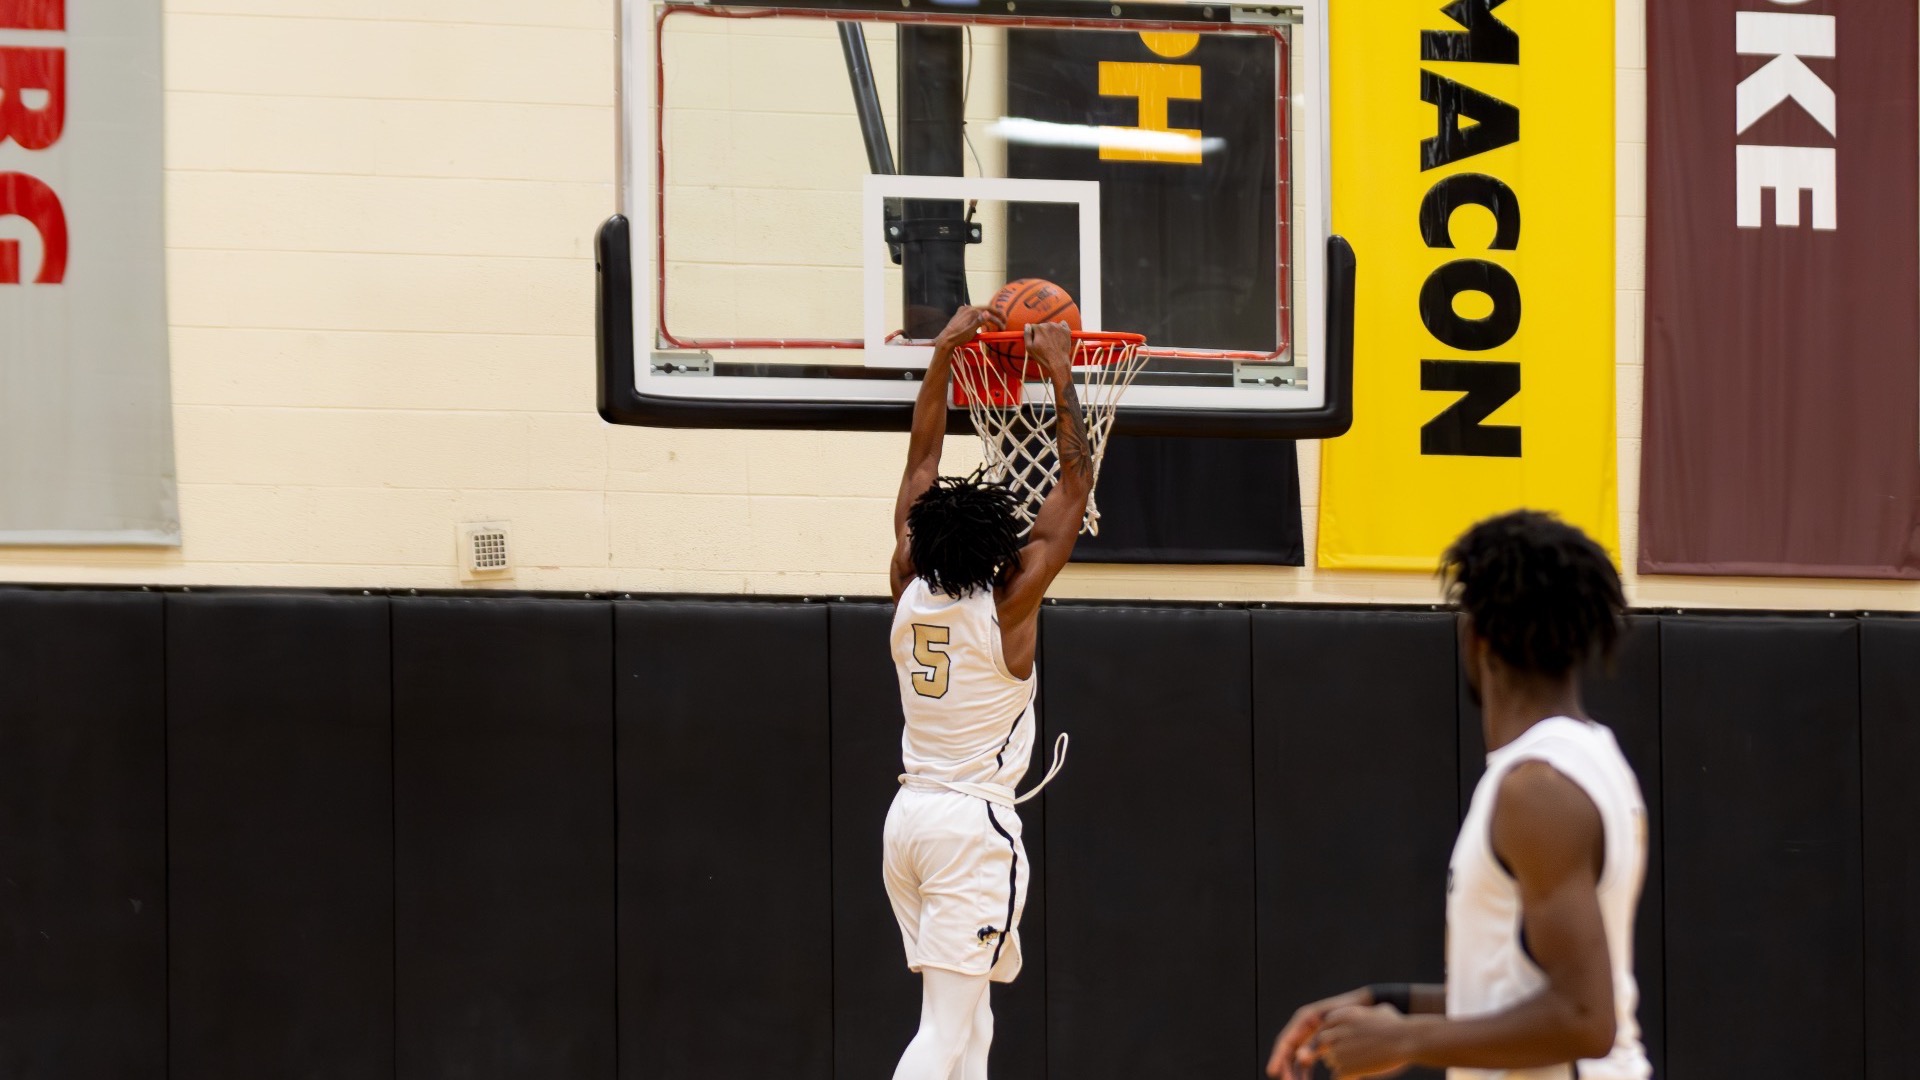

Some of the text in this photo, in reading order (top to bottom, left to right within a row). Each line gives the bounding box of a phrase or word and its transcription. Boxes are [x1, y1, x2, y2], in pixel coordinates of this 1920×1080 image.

[1419, 0, 1522, 458] MACON
[1735, 0, 1836, 230] KE
[911, 623, 951, 699] 5
